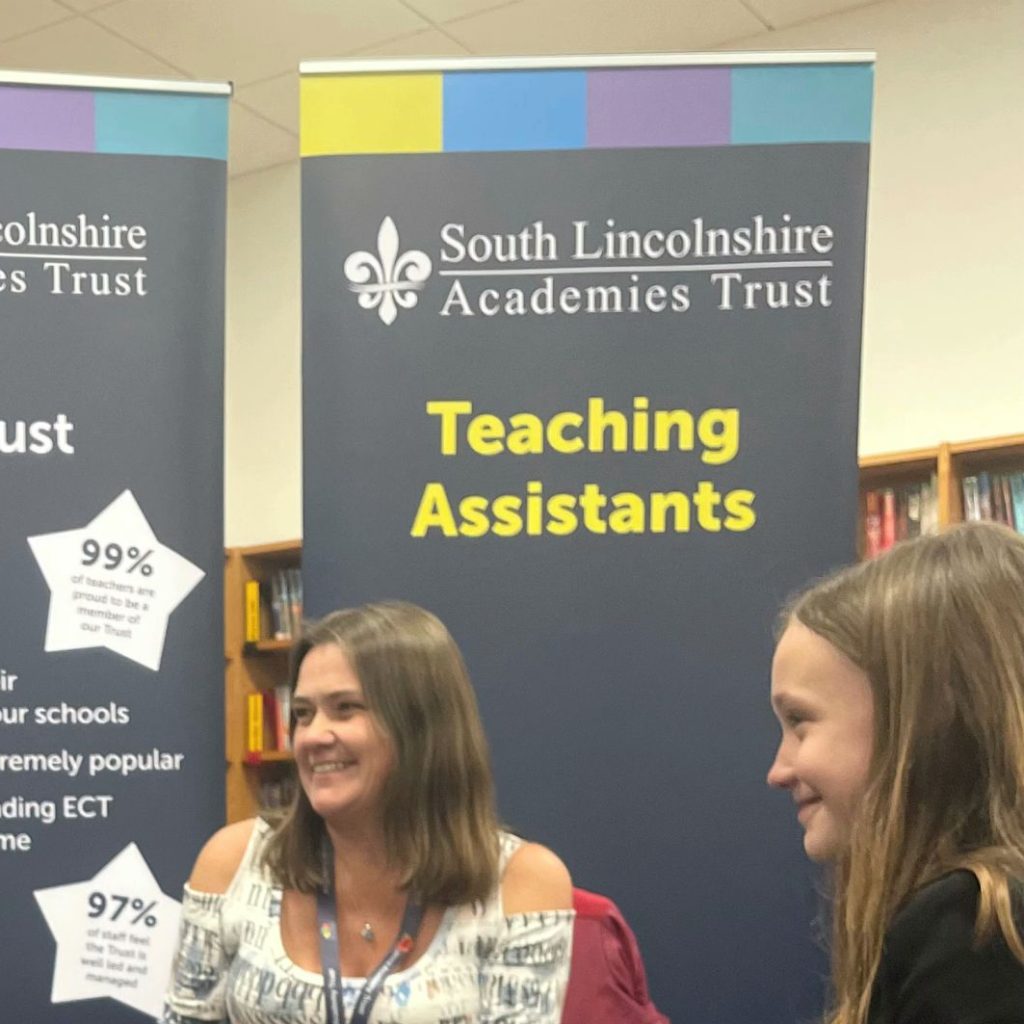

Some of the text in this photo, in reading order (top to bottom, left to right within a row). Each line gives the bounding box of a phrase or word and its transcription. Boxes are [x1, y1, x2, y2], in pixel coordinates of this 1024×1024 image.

[440, 214, 833, 263] South Lincolnshire
[43, 262, 147, 296] Trust
[439, 272, 831, 316] Academies Trust
[426, 396, 740, 465] Teaching
[410, 481, 756, 538] Assistants
[81, 538, 153, 577] 99%
[34, 701, 130, 725] schools
[89, 748, 185, 777] popular
[63, 795, 113, 818] ECT
[87, 891, 157, 928] 97%
